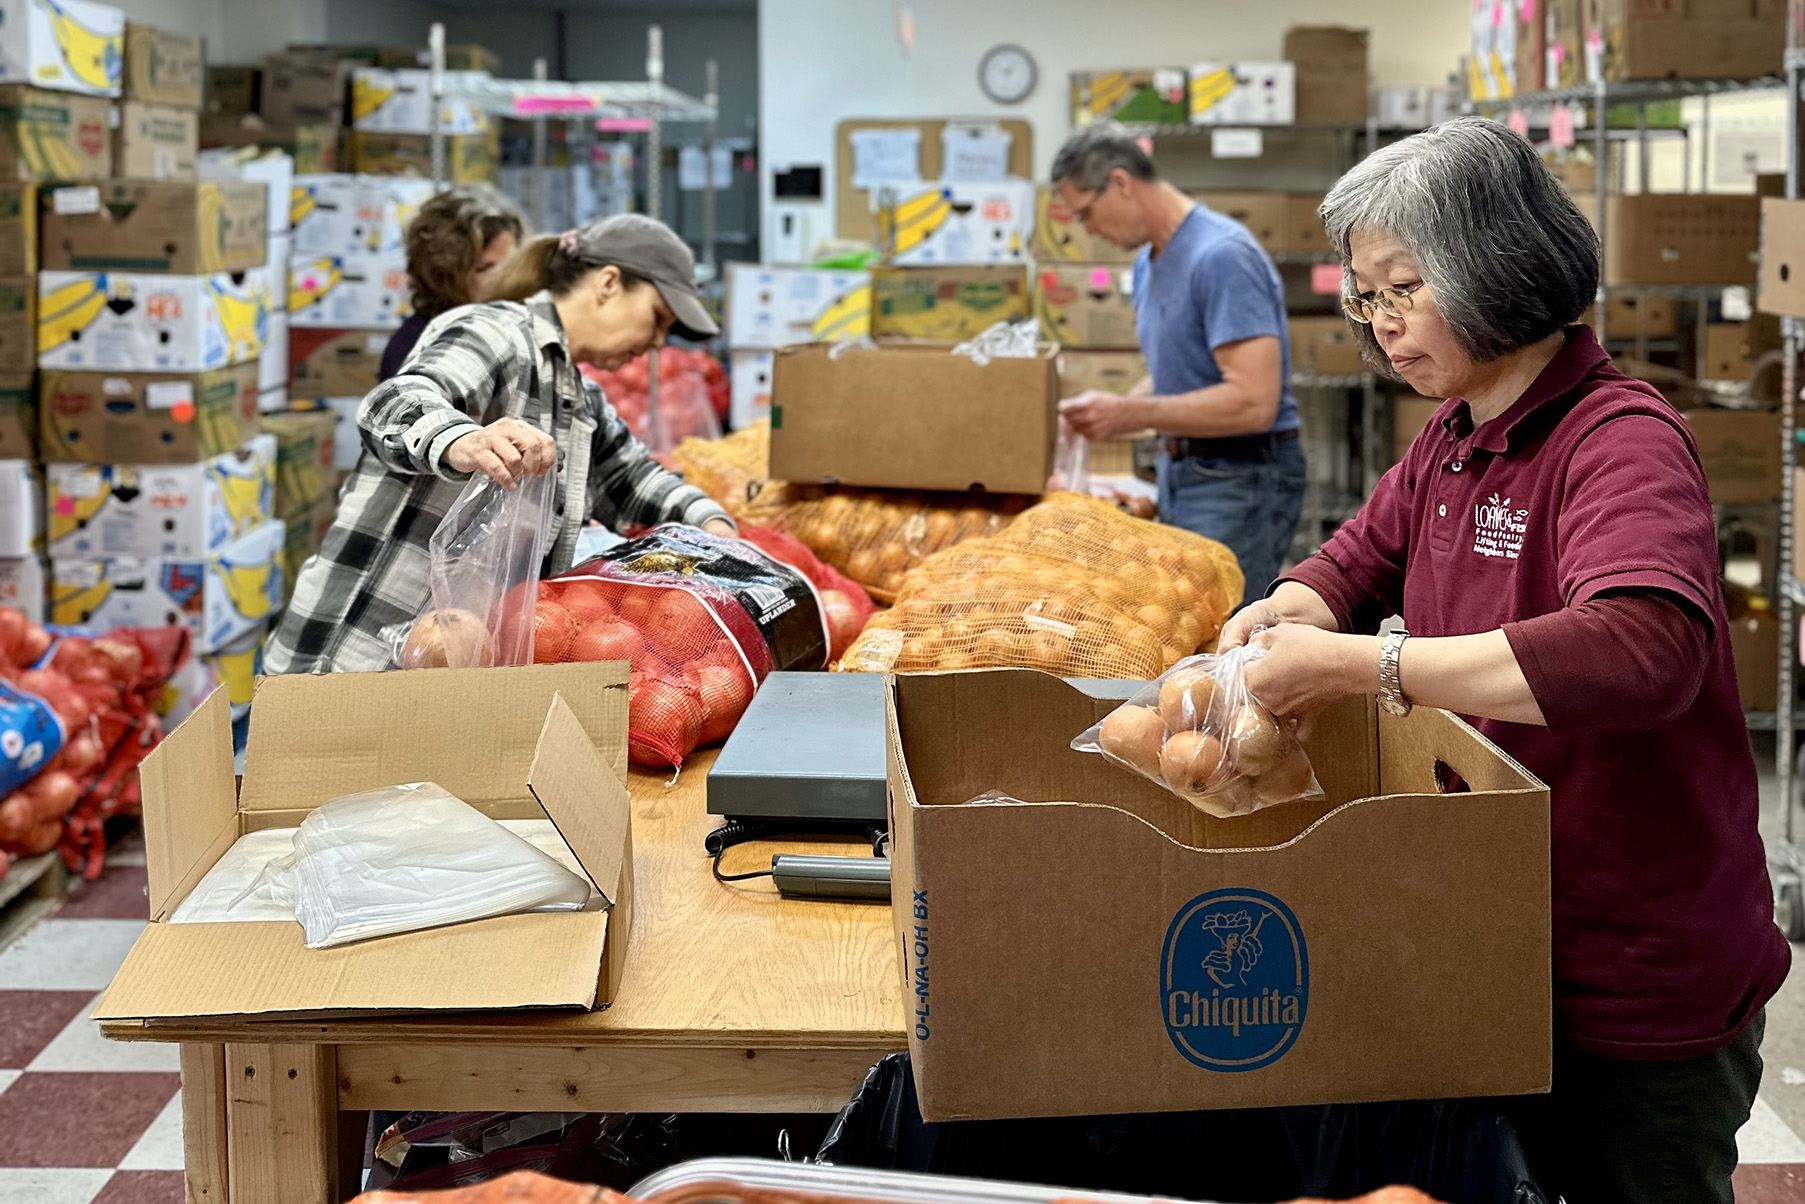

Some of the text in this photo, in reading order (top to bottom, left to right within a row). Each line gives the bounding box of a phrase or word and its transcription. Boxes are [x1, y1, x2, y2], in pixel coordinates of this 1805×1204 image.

[1475, 504, 1509, 531] LOAVES
[1475, 528, 1498, 538] Food
[1475, 536, 1498, 549] Lifting
[759, 599, 796, 625] UPLANDER
[913, 889, 931, 1041] O-L-NA-OH BX
[1168, 987, 1300, 1037] Chiquita
